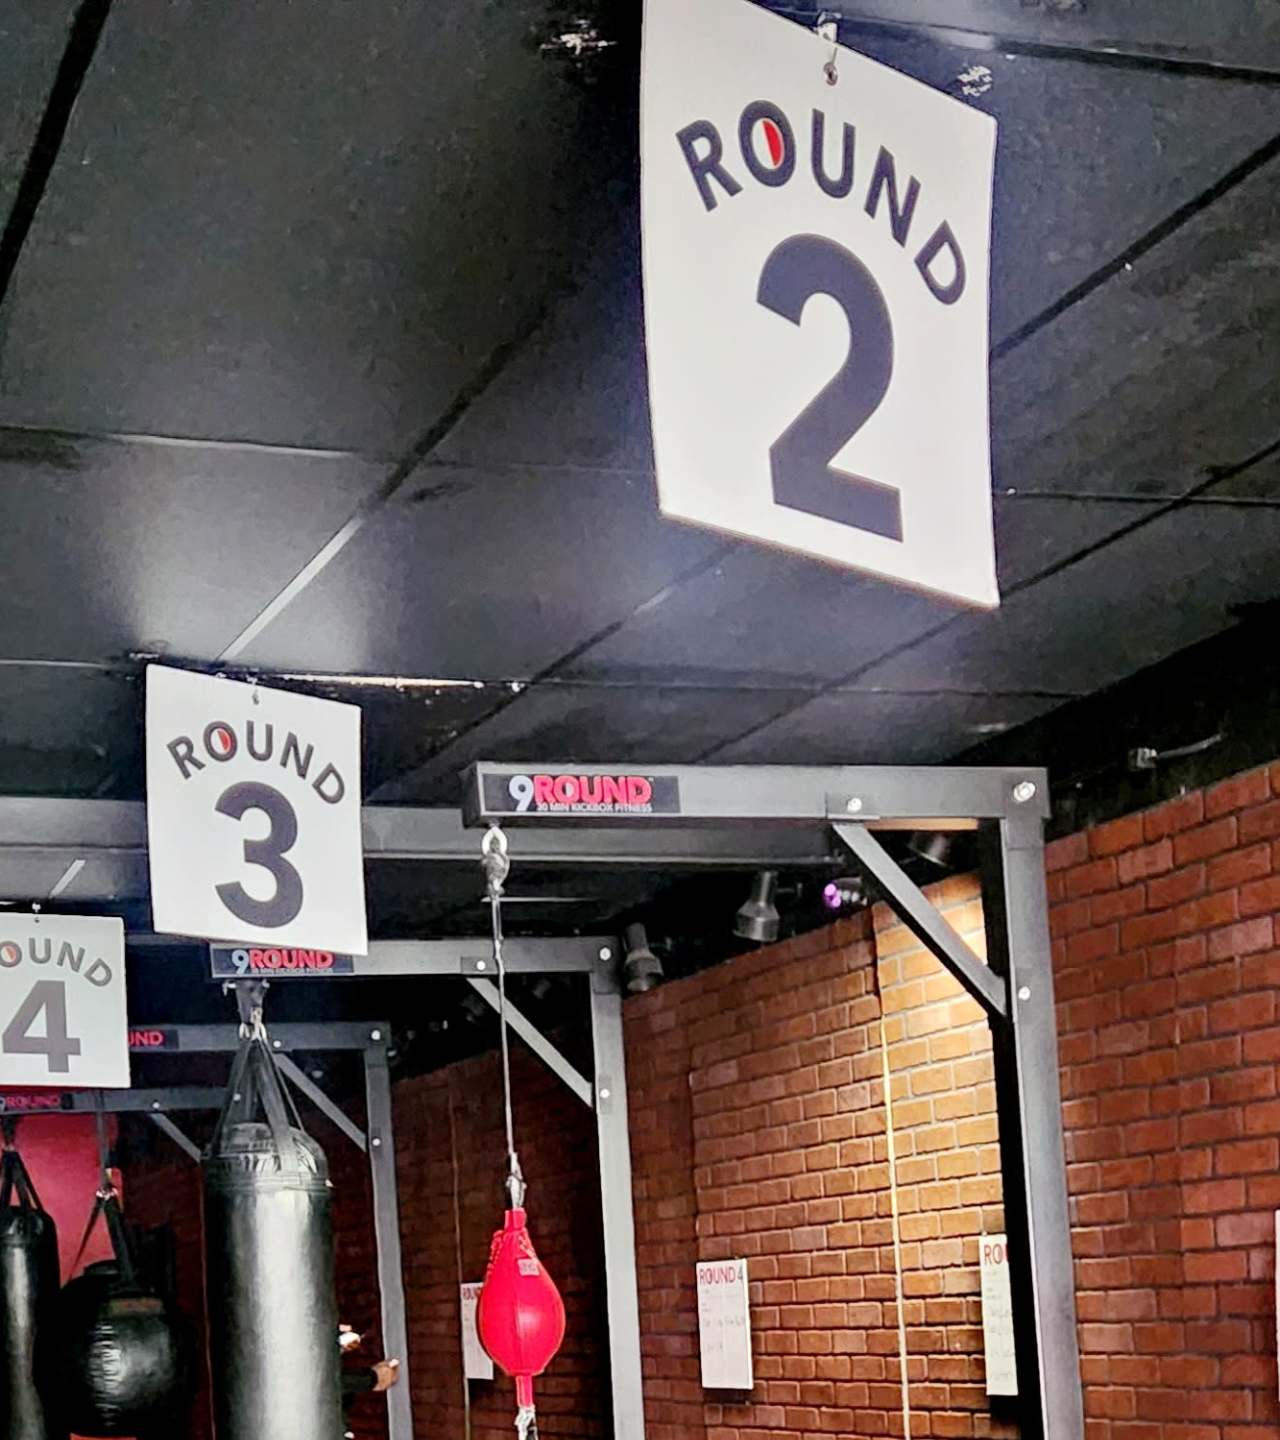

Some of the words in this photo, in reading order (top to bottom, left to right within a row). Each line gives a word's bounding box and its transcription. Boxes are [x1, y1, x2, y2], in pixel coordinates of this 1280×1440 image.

[676, 99, 966, 306] ROUND
[755, 232, 904, 544] 2
[166, 720, 346, 805] ROUND
[508, 774, 653, 812] 9ROUND
[214, 781, 304, 929] 3
[231, 948, 334, 975] 9ROUND
[1, 979, 82, 1074] 4
[699, 1266, 736, 1286] ROUND
